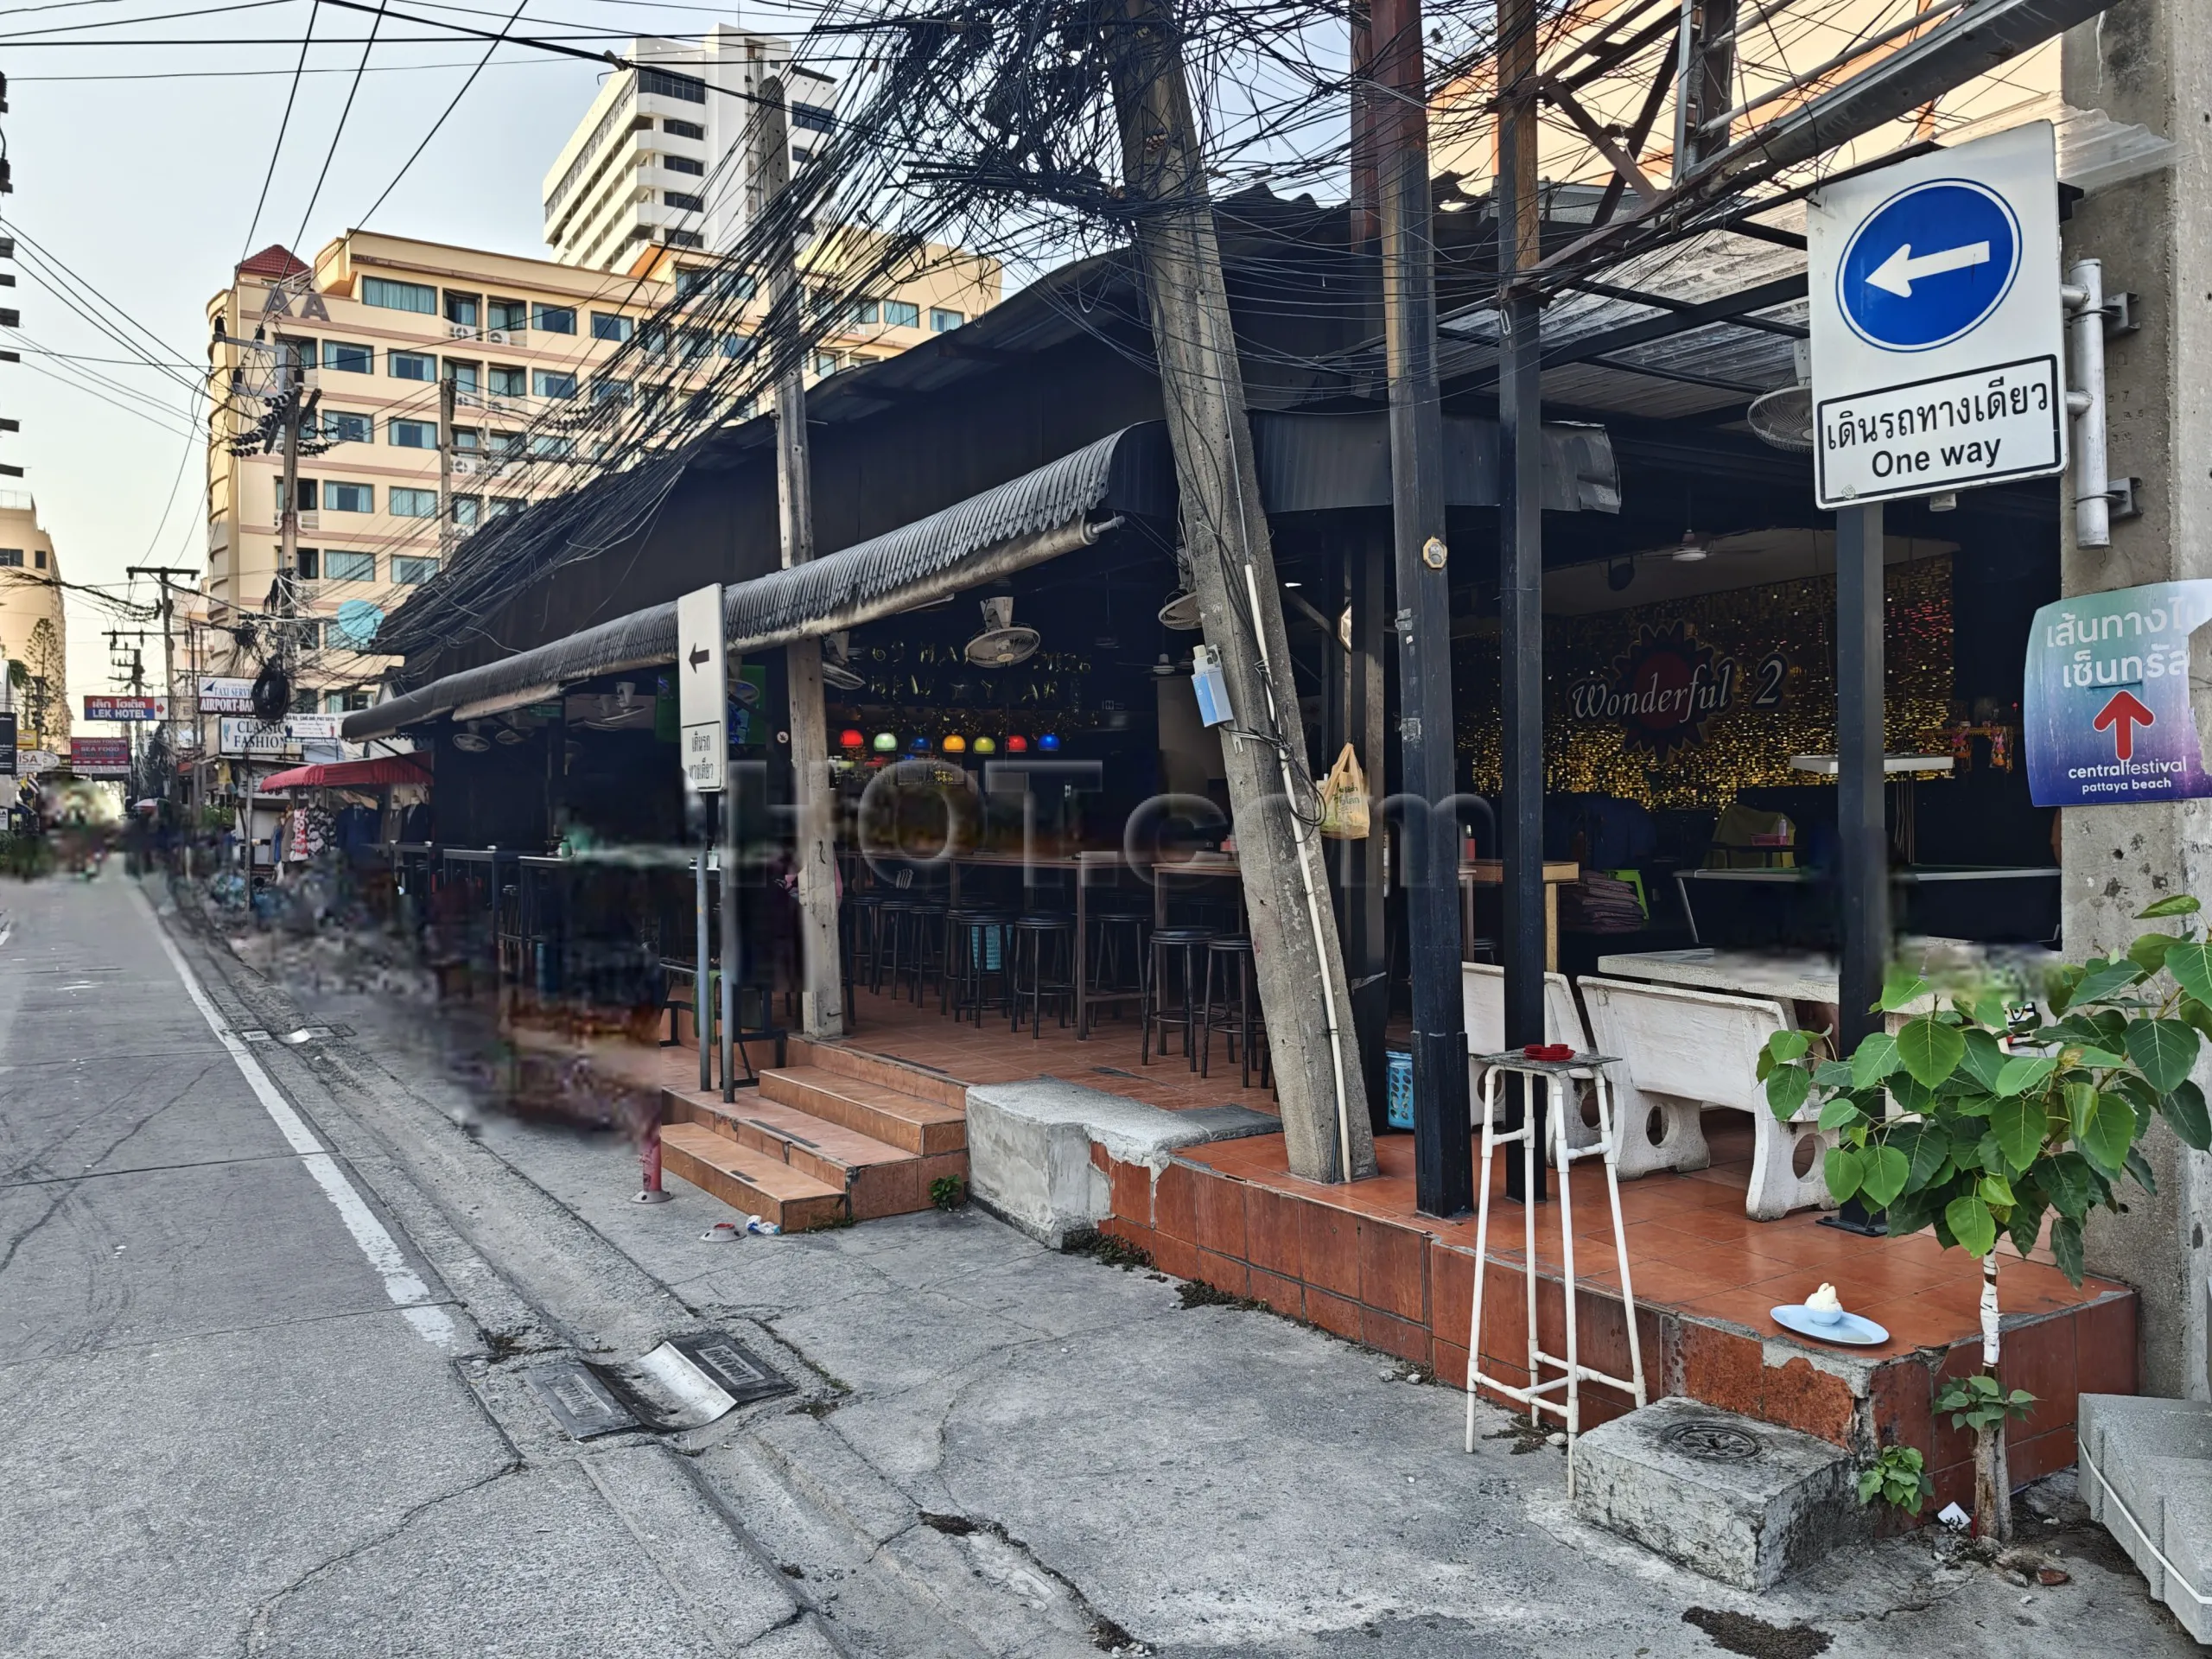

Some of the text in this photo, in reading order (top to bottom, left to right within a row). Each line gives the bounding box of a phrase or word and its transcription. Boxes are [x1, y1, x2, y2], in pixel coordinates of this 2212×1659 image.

[1827, 376, 2048, 449] เดินรถทางเดียว
[1872, 438, 2002, 477] One way
[2063, 644, 2190, 688] เซ็นทรัล
[214, 688, 251, 697] TAXI SERVI
[1572, 659, 1783, 724] Wonderful 2
[200, 697, 255, 712] AIRPORT-BAN
[92, 709, 147, 718] LEK HOTEL
[237, 721, 284, 735] CLASSIC
[18, 753, 38, 764] ISA
[2068, 756, 2187, 779] centralfestival
[2082, 777, 2171, 794] pattaya beach
